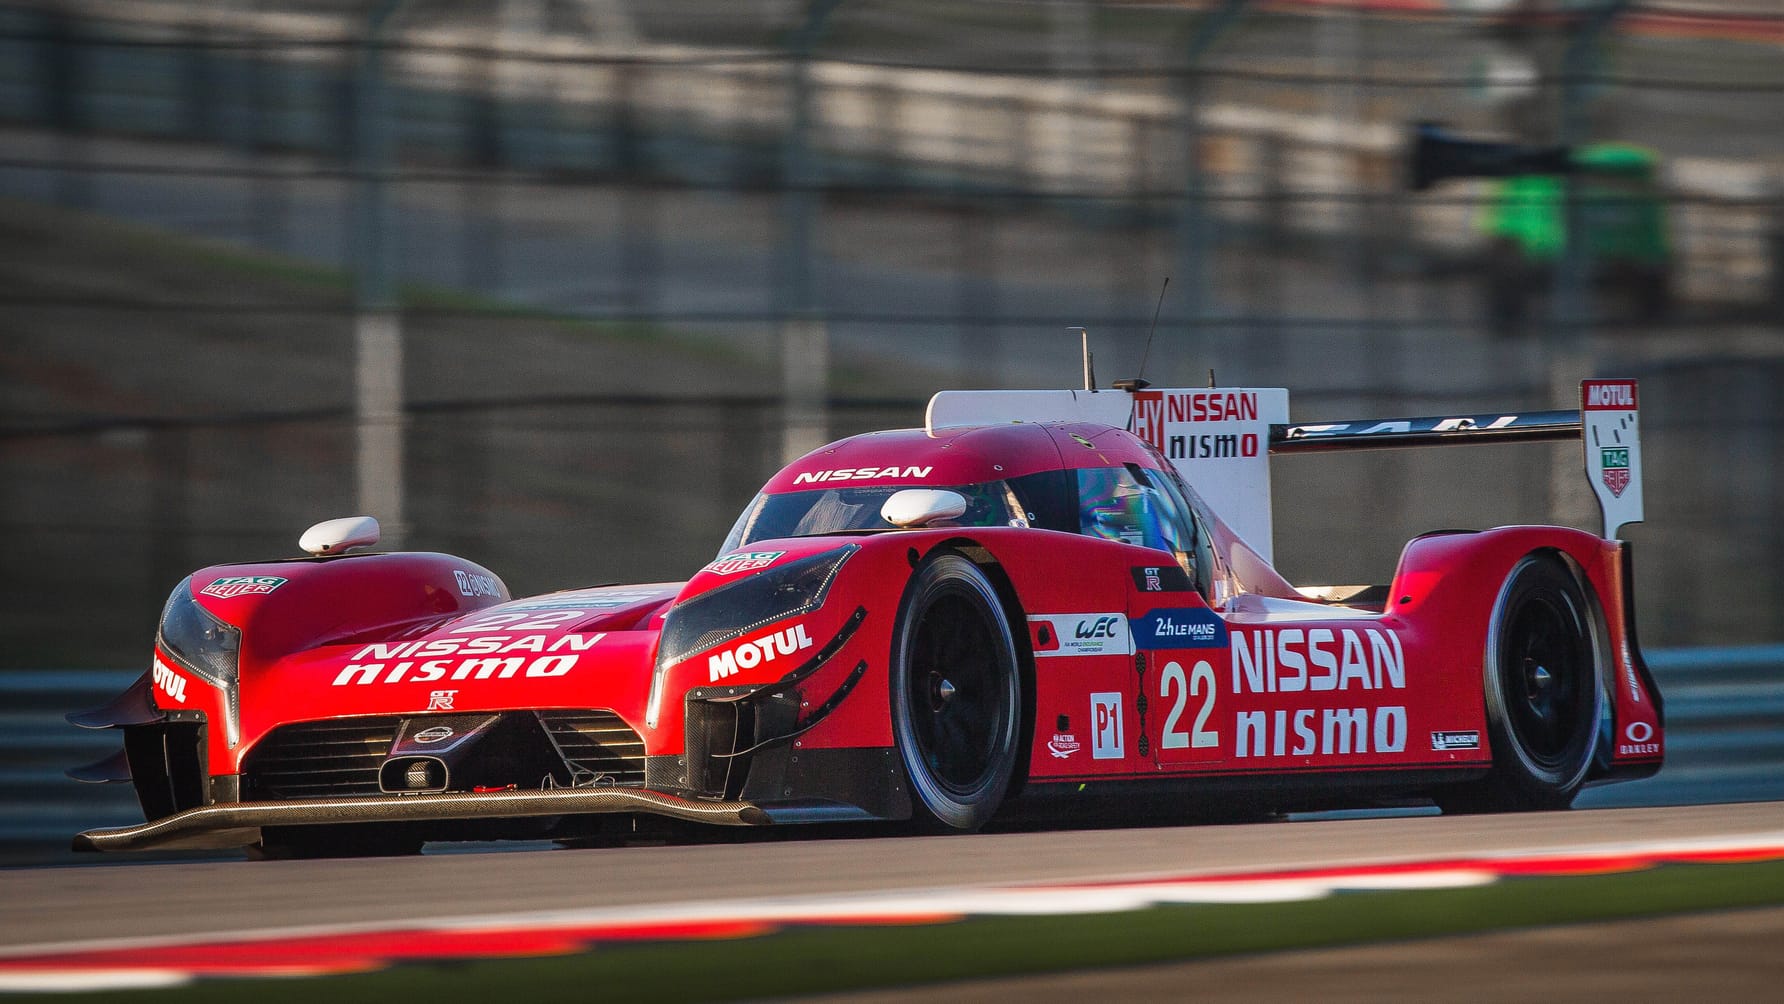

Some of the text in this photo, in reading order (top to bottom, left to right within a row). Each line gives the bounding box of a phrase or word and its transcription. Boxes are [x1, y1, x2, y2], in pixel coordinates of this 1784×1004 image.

[1587, 385, 1634, 406] MOTUL
[1168, 393, 1258, 423] NISSAN
[1169, 433, 1259, 459] nismo
[1603, 451, 1629, 467] TAG
[793, 466, 934, 485] NISSAN
[218, 577, 283, 586] TAG
[1144, 568, 1160, 576] GT
[205, 583, 272, 597] HEUER
[1146, 576, 1162, 591] R
[450, 611, 585, 634] 22
[1075, 616, 1119, 639] WEC
[1175, 624, 1187, 636] LE
[1188, 623, 1215, 635] MANS
[351, 633, 607, 661] NISSAN
[708, 624, 813, 682] MOTUL
[332, 654, 580, 686] nismo
[1230, 629, 1406, 694] NISSAN
[427, 697, 454, 710] R
[430, 690, 459, 698] GT
[1160, 660, 1219, 749] 22
[1096, 702, 1119, 749] P1
[1235, 706, 1408, 758] nismo
[1620, 743, 1660, 755] OAKLEY
